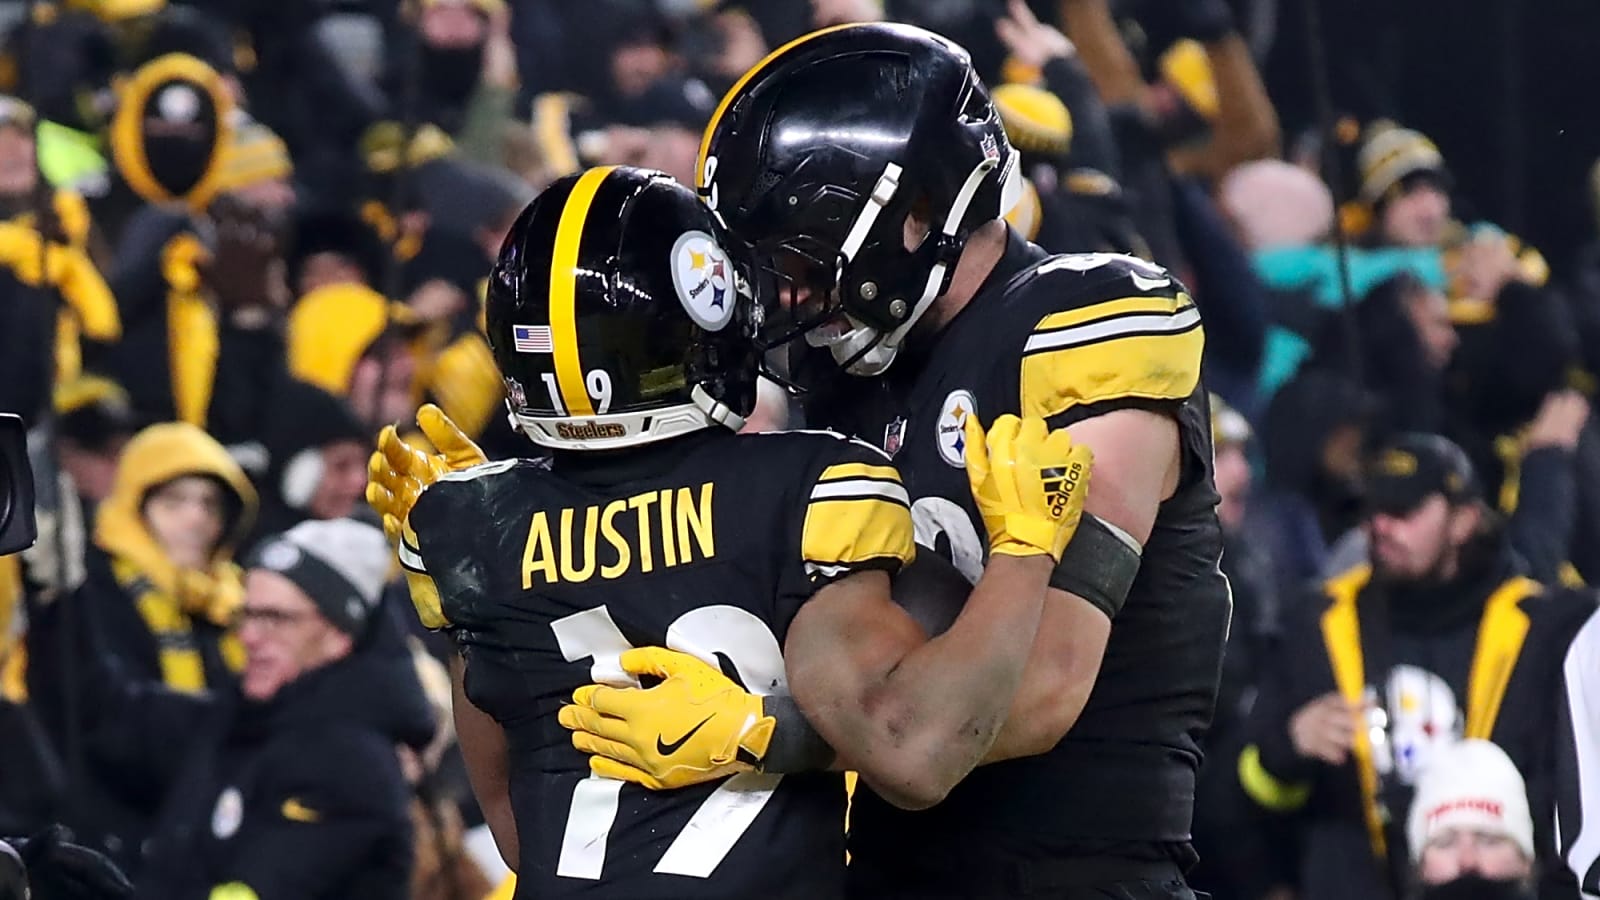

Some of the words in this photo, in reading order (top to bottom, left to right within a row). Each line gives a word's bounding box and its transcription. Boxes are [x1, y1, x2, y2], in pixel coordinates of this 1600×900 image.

[557, 421, 626, 440] Steelers
[1051, 462, 1082, 517] adidas
[522, 482, 715, 589] AUSTIN
